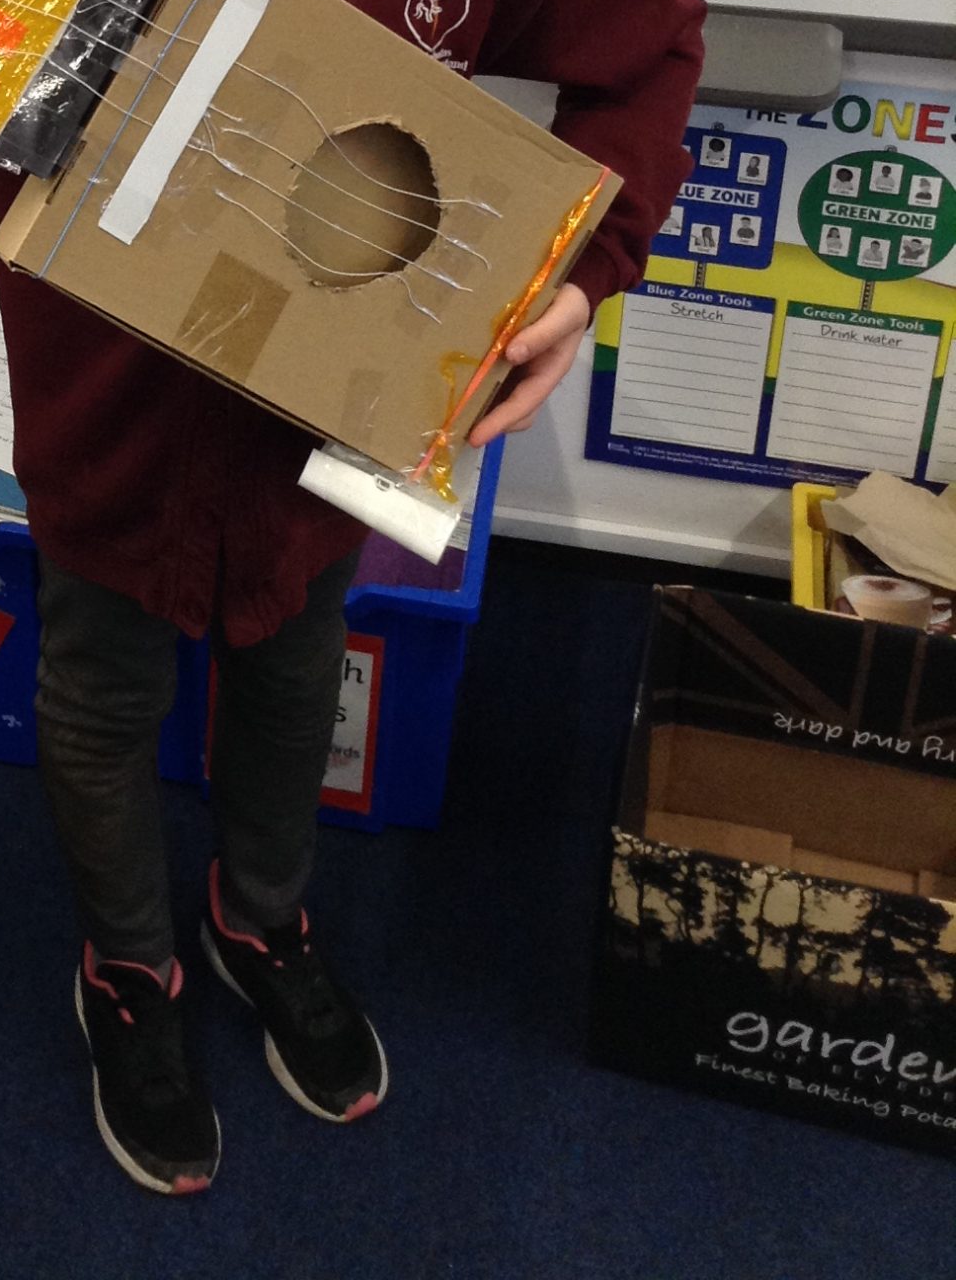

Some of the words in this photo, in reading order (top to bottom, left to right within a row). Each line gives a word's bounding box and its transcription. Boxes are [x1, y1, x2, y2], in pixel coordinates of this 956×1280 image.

[711, 187, 755, 206] ZONE
[826, 204, 881, 221] GREEN
[887, 212, 933, 228] ZONE
[647, 284, 675, 297] Blue
[679, 289, 713, 303] Zone
[718, 293, 752, 308] Tools
[671, 302, 723, 321] Stretch
[803, 306, 846, 321] Green
[850, 312, 885, 326] Zone
[888, 317, 924, 332] Tools
[821, 325, 860, 342] Drink
[863, 333, 904, 348] water
[773, 712, 843, 742] dark
[852, 731, 911, 753] and
[696, 1053, 776, 1083] Finest
[786, 1075, 890, 1116] Baking
